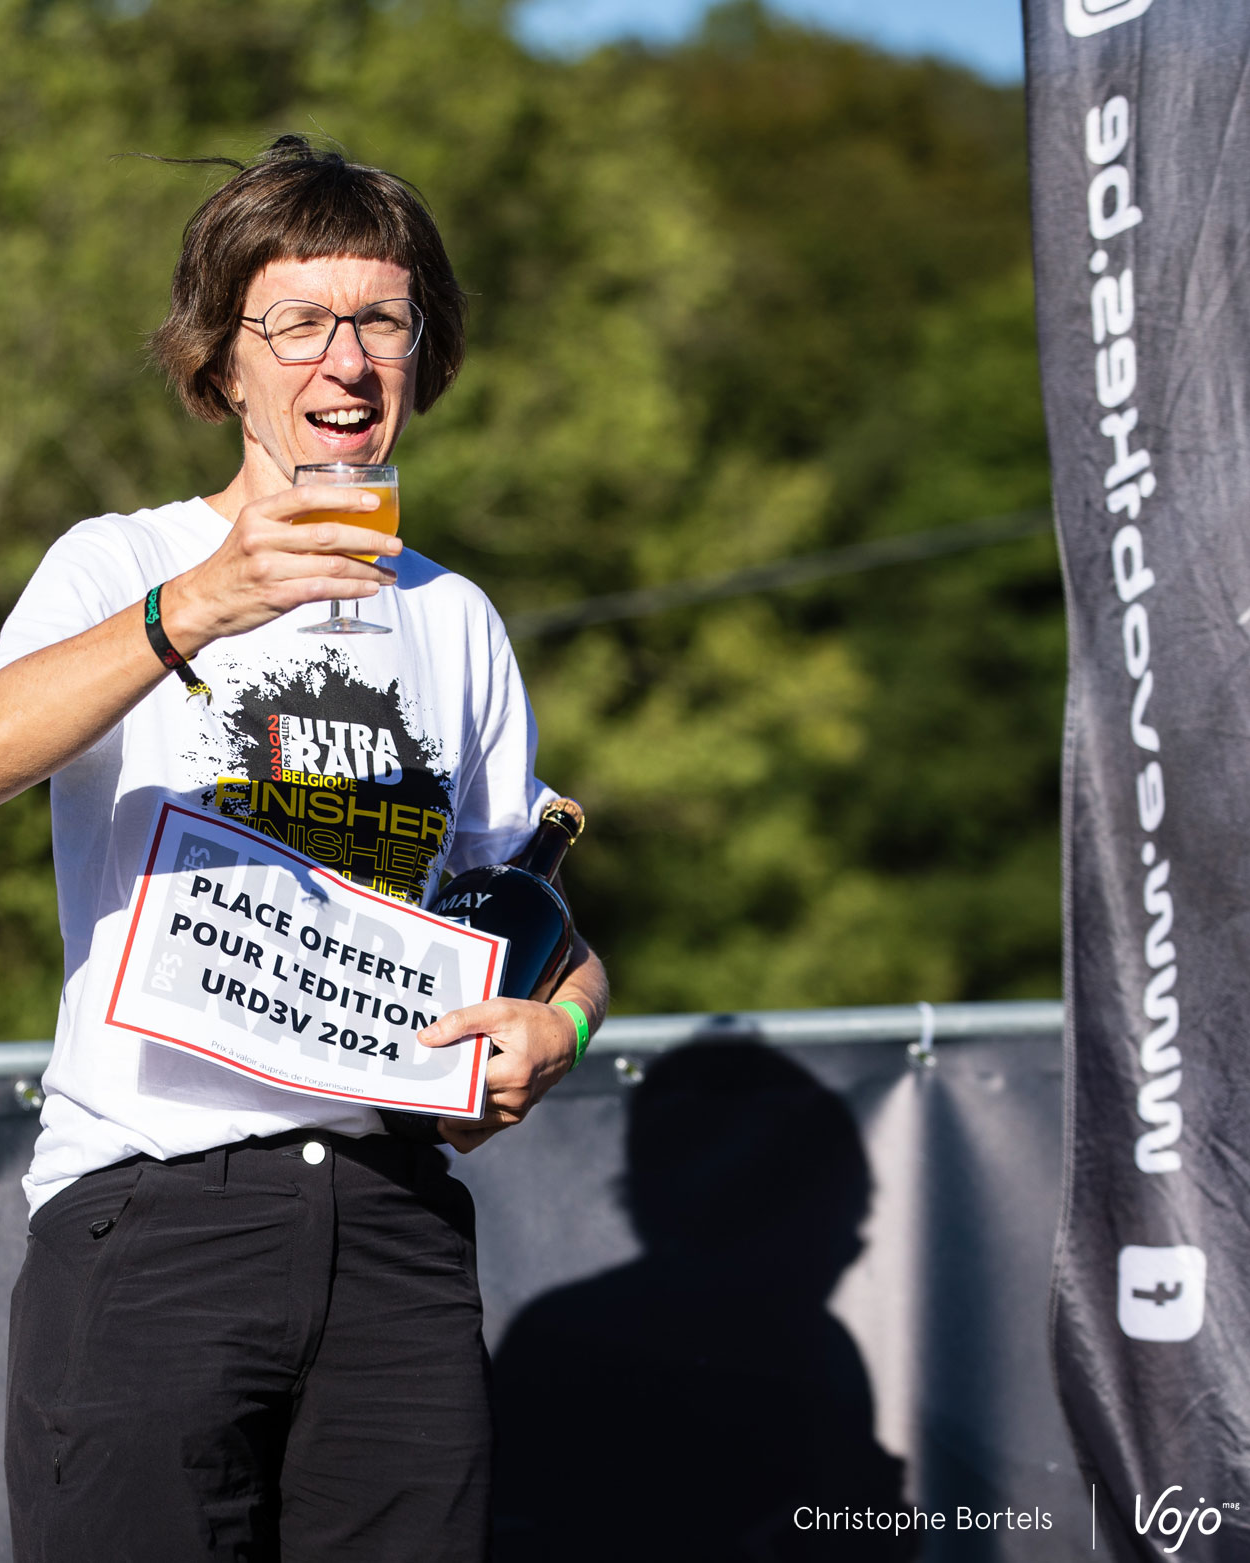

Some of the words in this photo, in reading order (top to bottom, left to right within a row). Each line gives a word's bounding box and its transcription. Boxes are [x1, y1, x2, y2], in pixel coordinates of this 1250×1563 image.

[267, 714, 282, 782] 2023
[283, 754, 292, 768] DES
[291, 715, 399, 757] ULTRA
[296, 741, 403, 786] RAID
[281, 769, 358, 793] BELGIQUE
[214, 776, 448, 846] FINISHER
[190, 875, 293, 937] PLACE
[299, 925, 435, 996] OFFERTE
[169, 912, 264, 969] POUR
[273, 954, 439, 1031] L'EDITION
[201, 967, 312, 1034] URD3V
[318, 1021, 400, 1062] 2024
[211, 1040, 227, 1053] Prix
[235, 1052, 258, 1066] valoir
[291, 1072, 303, 1082] de
